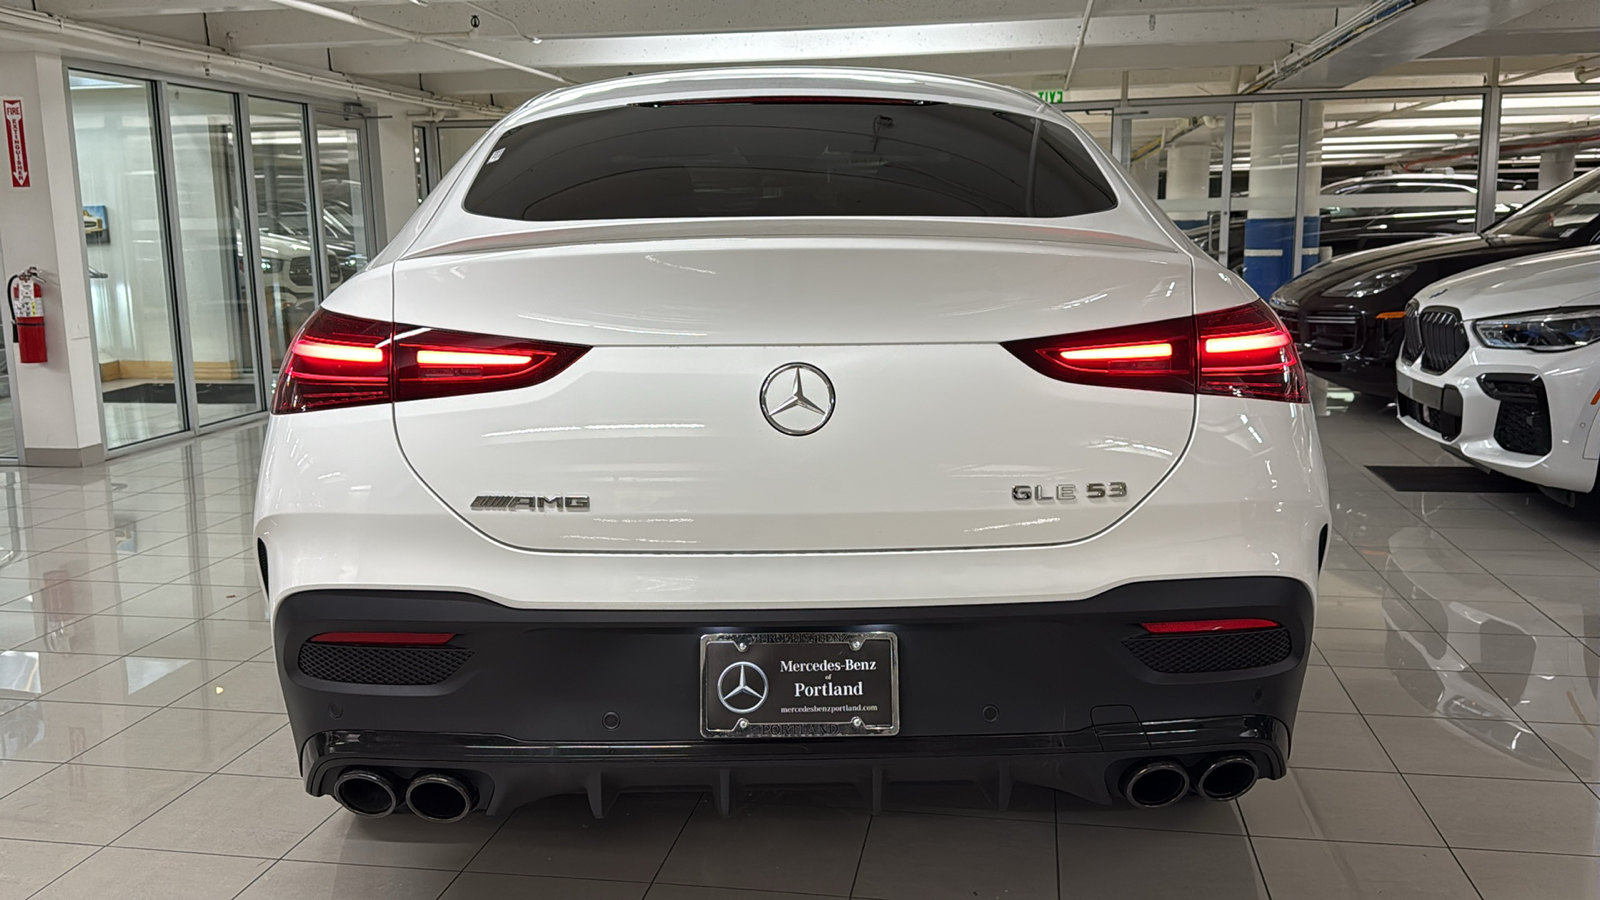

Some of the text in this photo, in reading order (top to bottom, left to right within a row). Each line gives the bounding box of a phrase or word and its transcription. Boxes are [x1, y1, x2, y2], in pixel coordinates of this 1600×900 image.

[6, 107, 20, 115] FIRE
[12, 119, 24, 180] EXTINGUISHER
[1012, 481, 1127, 500] GLE 53
[508, 496, 590, 509] AMG
[780, 659, 877, 673] Mercedes-Benz
[794, 682, 863, 698] Portland
[780, 704, 878, 714] mercedesbenzportland.com
[761, 724, 840, 736] PORTLAND
